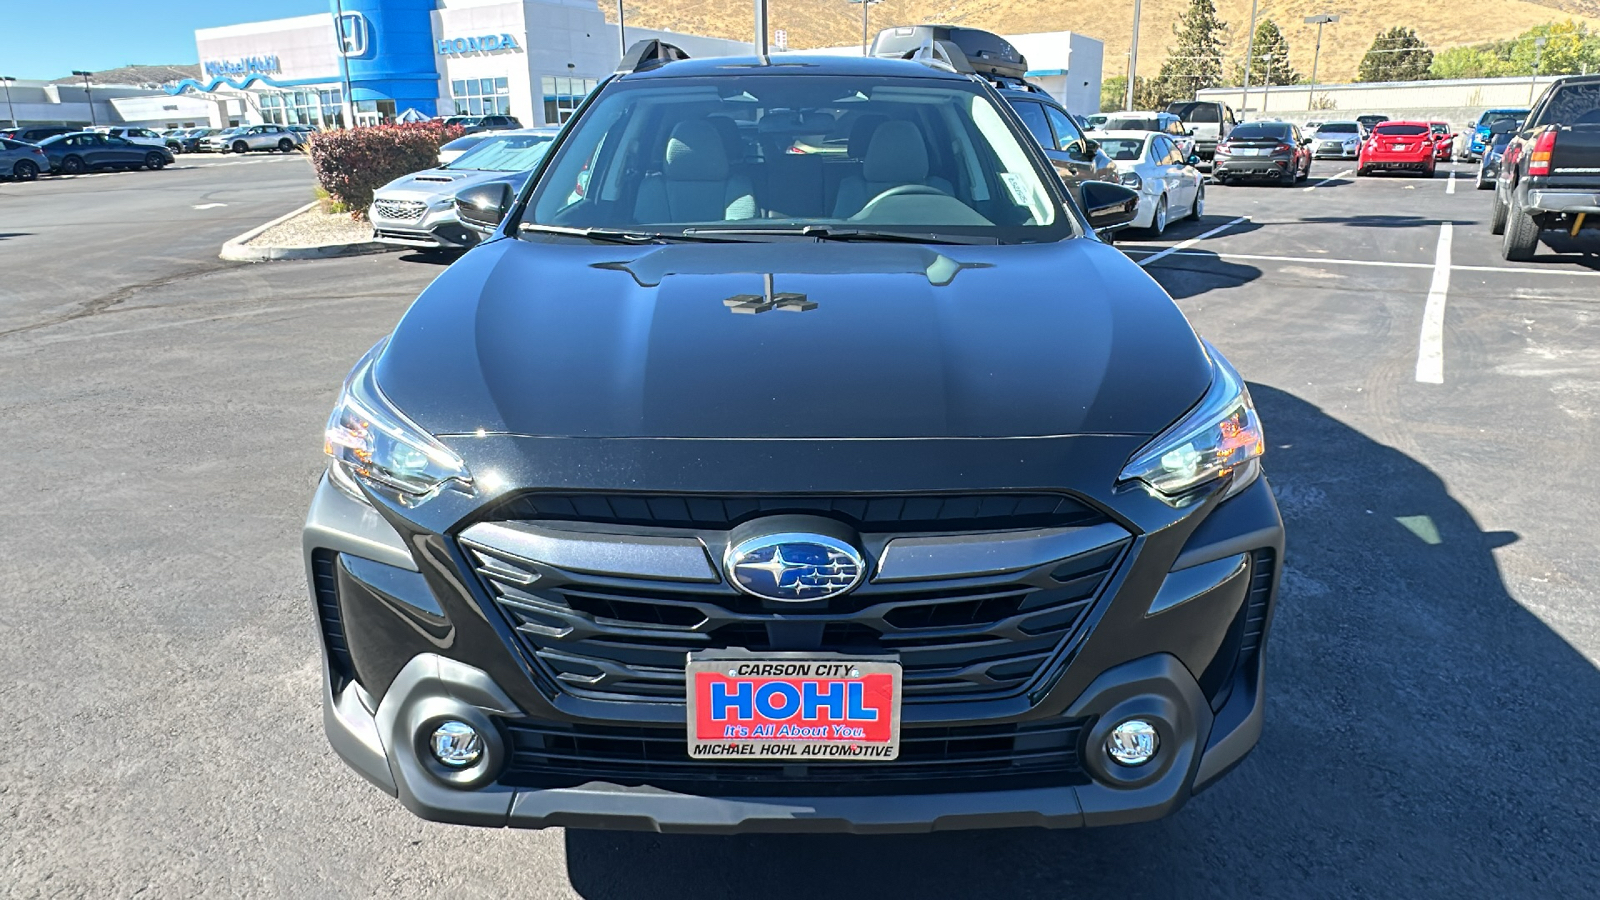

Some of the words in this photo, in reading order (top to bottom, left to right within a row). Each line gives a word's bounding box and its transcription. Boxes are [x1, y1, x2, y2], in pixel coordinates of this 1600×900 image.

[437, 33, 517, 55] HONDA
[738, 664, 811, 676] CARSON
[815, 664, 854, 676] CITY
[710, 681, 879, 721] HOHL
[724, 724, 748, 737] It's
[752, 724, 775, 737] All
[777, 724, 828, 737] About
[832, 724, 866, 738] You.
[693, 744, 755, 755] MICHAEL
[760, 744, 797, 755] HOHL
[801, 744, 893, 757] AUTOMOTIVE
